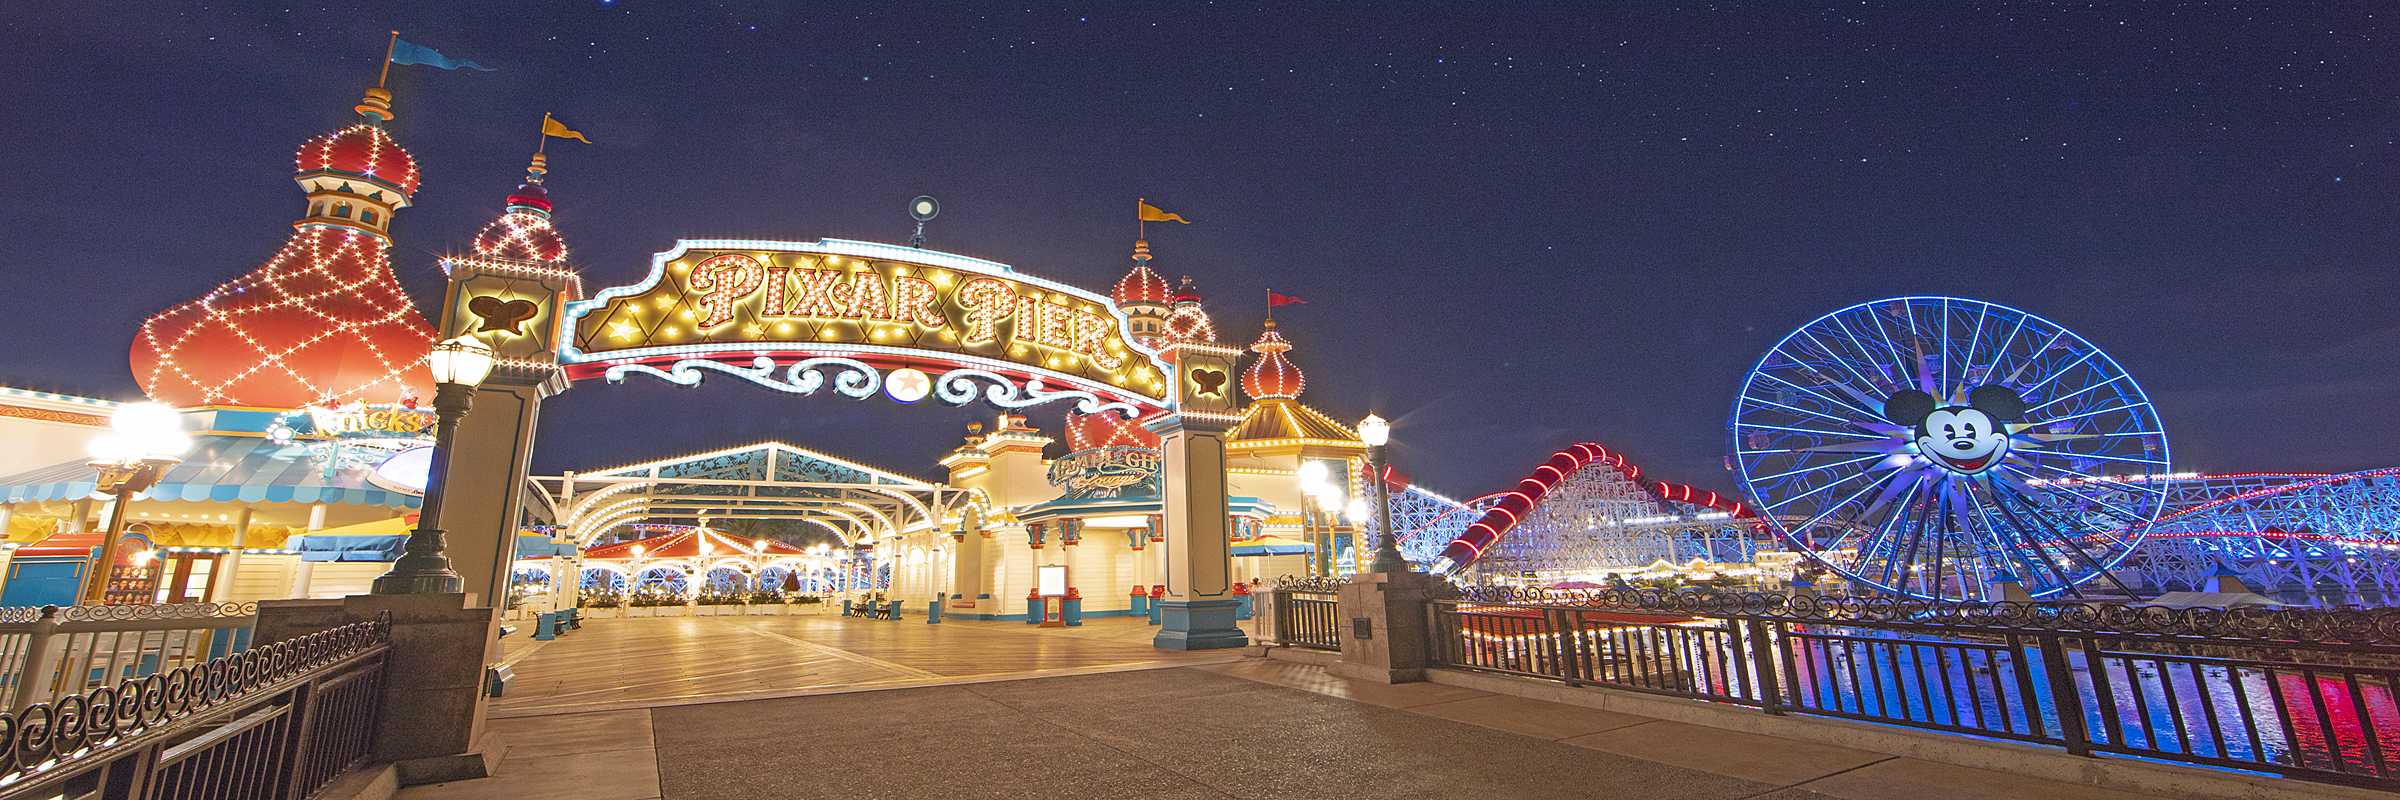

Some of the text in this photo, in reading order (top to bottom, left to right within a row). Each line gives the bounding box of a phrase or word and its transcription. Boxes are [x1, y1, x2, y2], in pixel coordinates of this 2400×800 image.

[690, 253, 1123, 370] PIXAR PIER
[1082, 473, 1147, 488] Lounge
